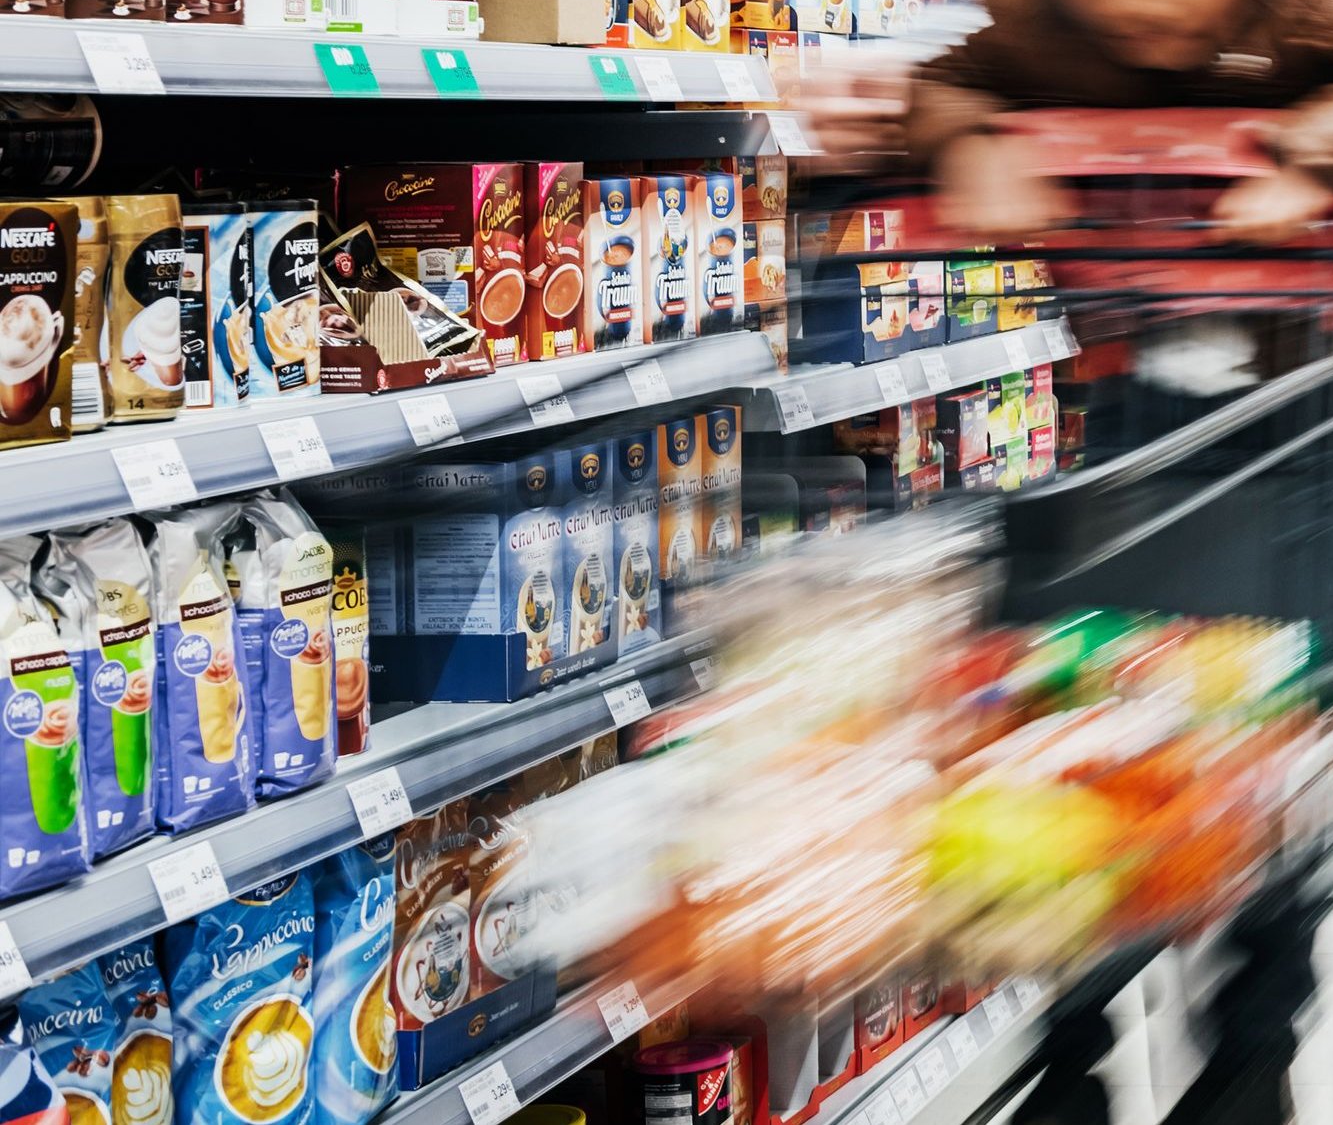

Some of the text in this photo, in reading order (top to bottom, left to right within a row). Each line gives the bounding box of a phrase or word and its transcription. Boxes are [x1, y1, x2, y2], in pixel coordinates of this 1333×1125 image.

[1, 222, 56, 248] NESCAFÉ
[11, 249, 46, 264] GOLD
[599, 278, 639, 309] Traum
[657, 273, 690, 302] Traum
[704, 269, 738, 297] Traum
[127, 398, 145, 410] 14
[331, 588, 366, 611] COB
[212, 979, 253, 1011] CLASSICO
[699, 1071, 714, 1090] GUT
